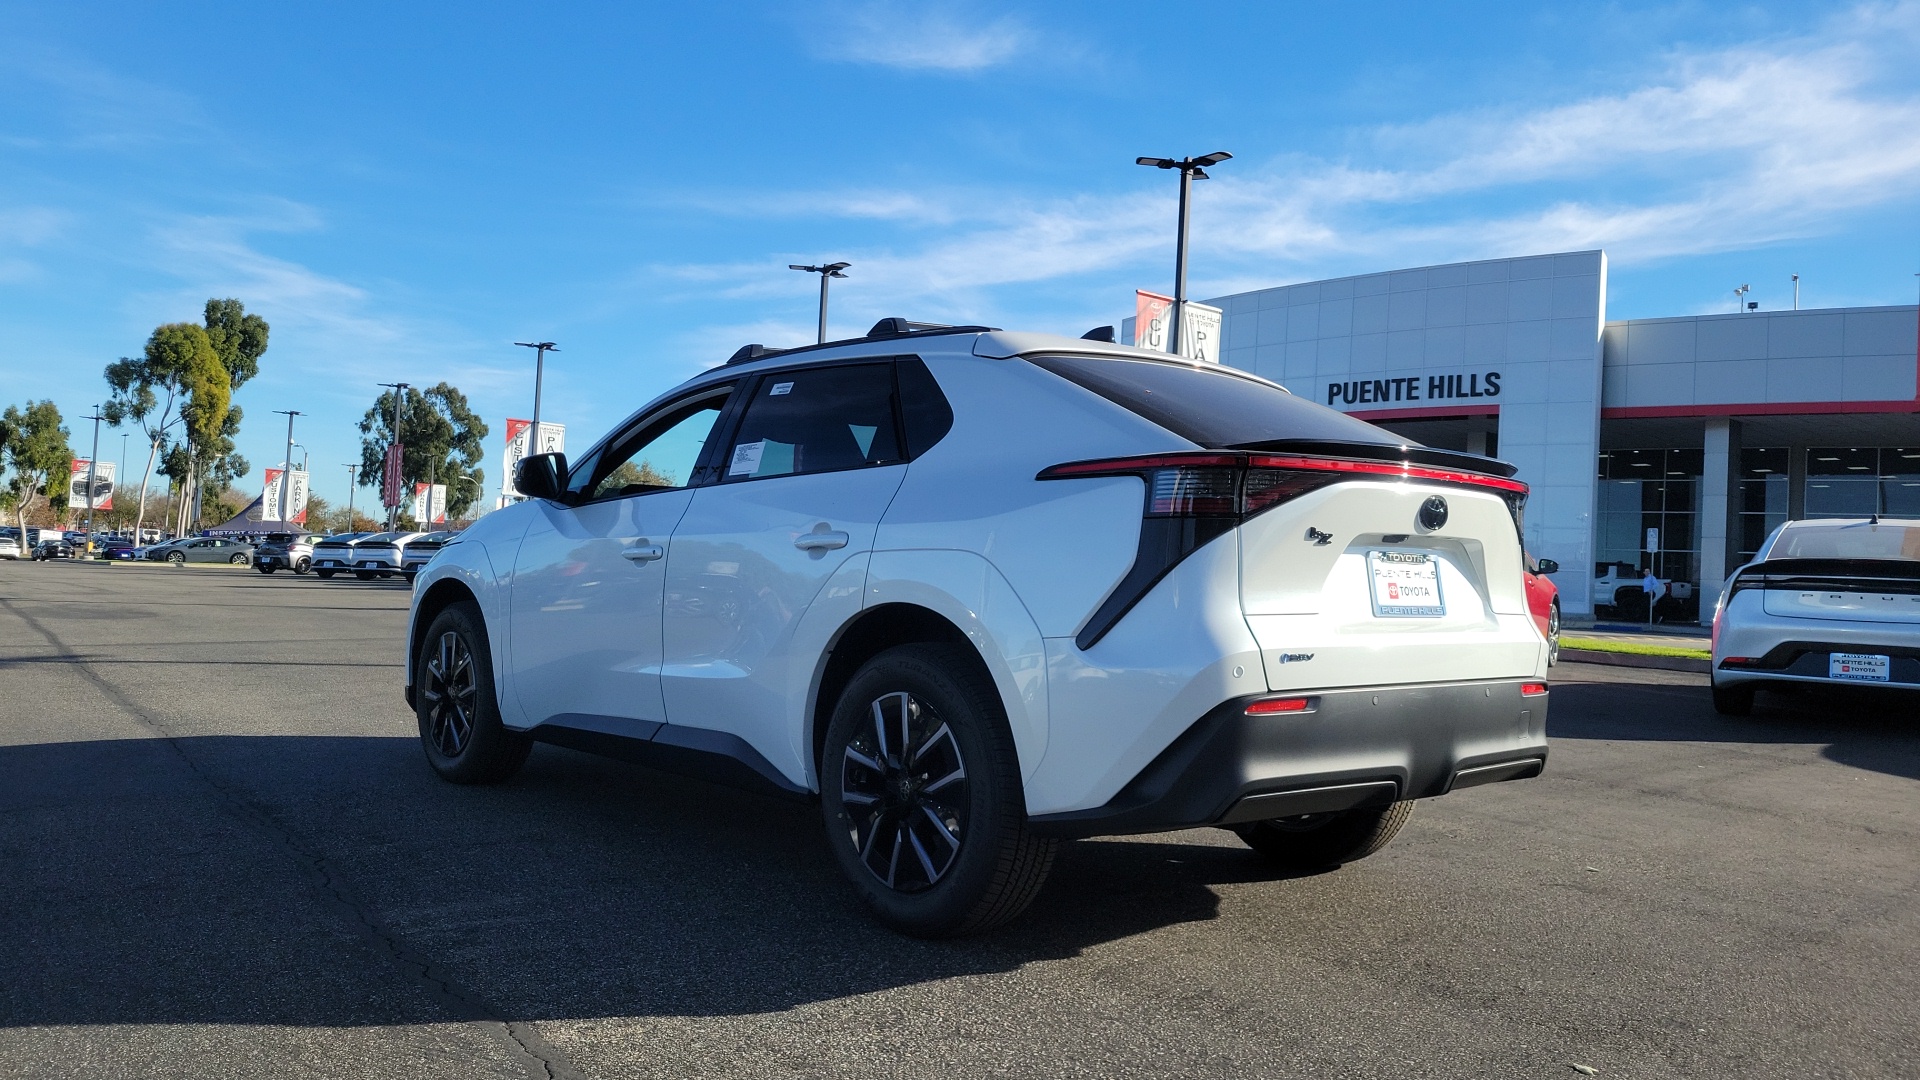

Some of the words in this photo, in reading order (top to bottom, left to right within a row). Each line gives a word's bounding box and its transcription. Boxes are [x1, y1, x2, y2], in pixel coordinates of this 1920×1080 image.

[1328, 377, 1420, 405] PUENTE
[1428, 372, 1501, 399] HILLS
[269, 477, 278, 518] CUSTOMER
[1386, 553, 1424, 563] TOYOTA
[1374, 569, 1411, 579] PUENTE
[1413, 570, 1437, 580] HILLS
[1399, 586, 1430, 597] TOYOTA
[1381, 606, 1418, 615] PUENTE
[1419, 607, 1443, 615] HILLS
